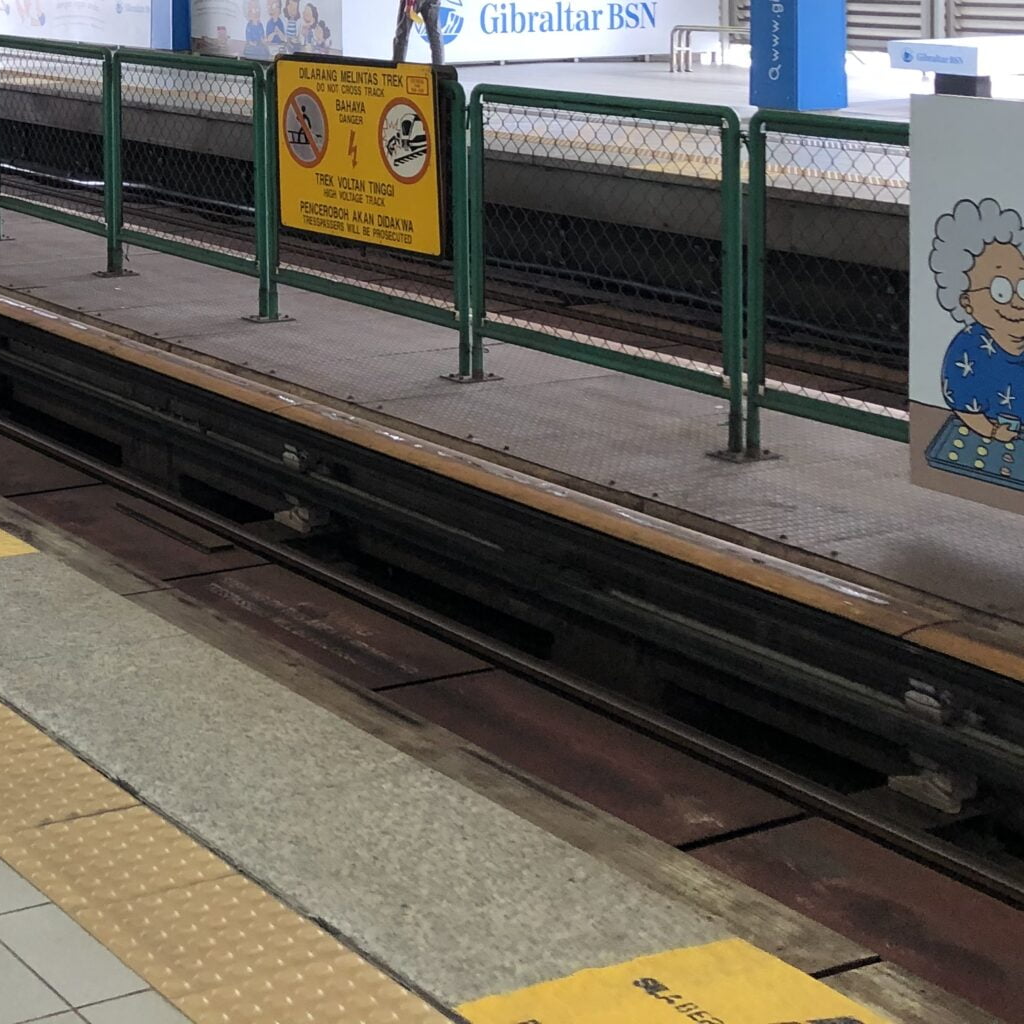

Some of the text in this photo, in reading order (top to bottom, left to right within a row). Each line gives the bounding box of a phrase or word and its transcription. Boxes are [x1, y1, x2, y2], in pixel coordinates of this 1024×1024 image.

[480, 1, 658, 35] Gibraltar BSN
[299, 67, 337, 82] DILARANG
[341, 70, 379, 86] MELINTAS
[382, 73, 403, 87] TREK
[316, 82, 384, 97] DO NOT CROSS TRACK
[335, 99, 366, 114] BAHAYA
[339, 114, 364, 125] DANGER
[315, 172, 394, 197] TREK VOLTAN TINGGI
[324, 188, 385, 207] HIGH VOLTAGE TRACK
[300, 201, 414, 232] PENCEROBOH AKAN DIDAKWA
[347, 224, 360, 235] WILL
[363, 226, 370, 236] BE
[373, 228, 412, 244] PROSECUTED
